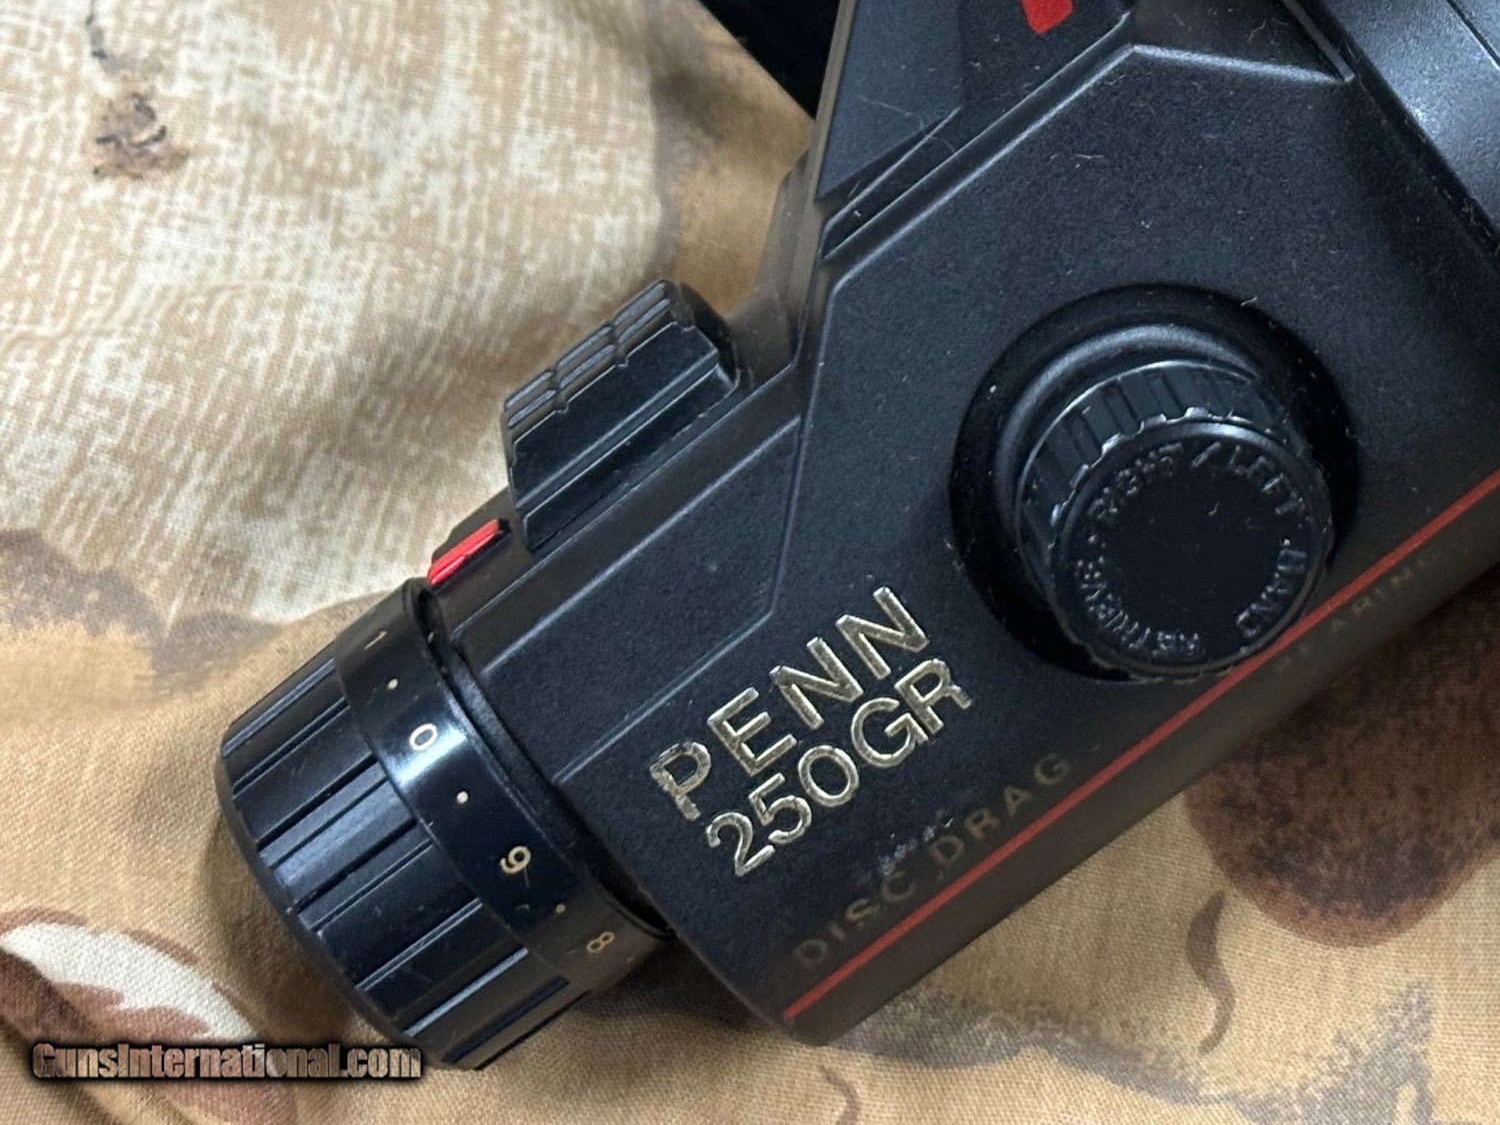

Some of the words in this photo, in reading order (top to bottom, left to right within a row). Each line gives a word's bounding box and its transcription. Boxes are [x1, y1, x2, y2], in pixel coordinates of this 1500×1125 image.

[648, 586, 932, 821] PENN
[704, 656, 975, 879] 250GR
[586, 931, 615, 954] 8
[792, 869, 919, 971] DISC
[925, 751, 1074, 869] DRAG
